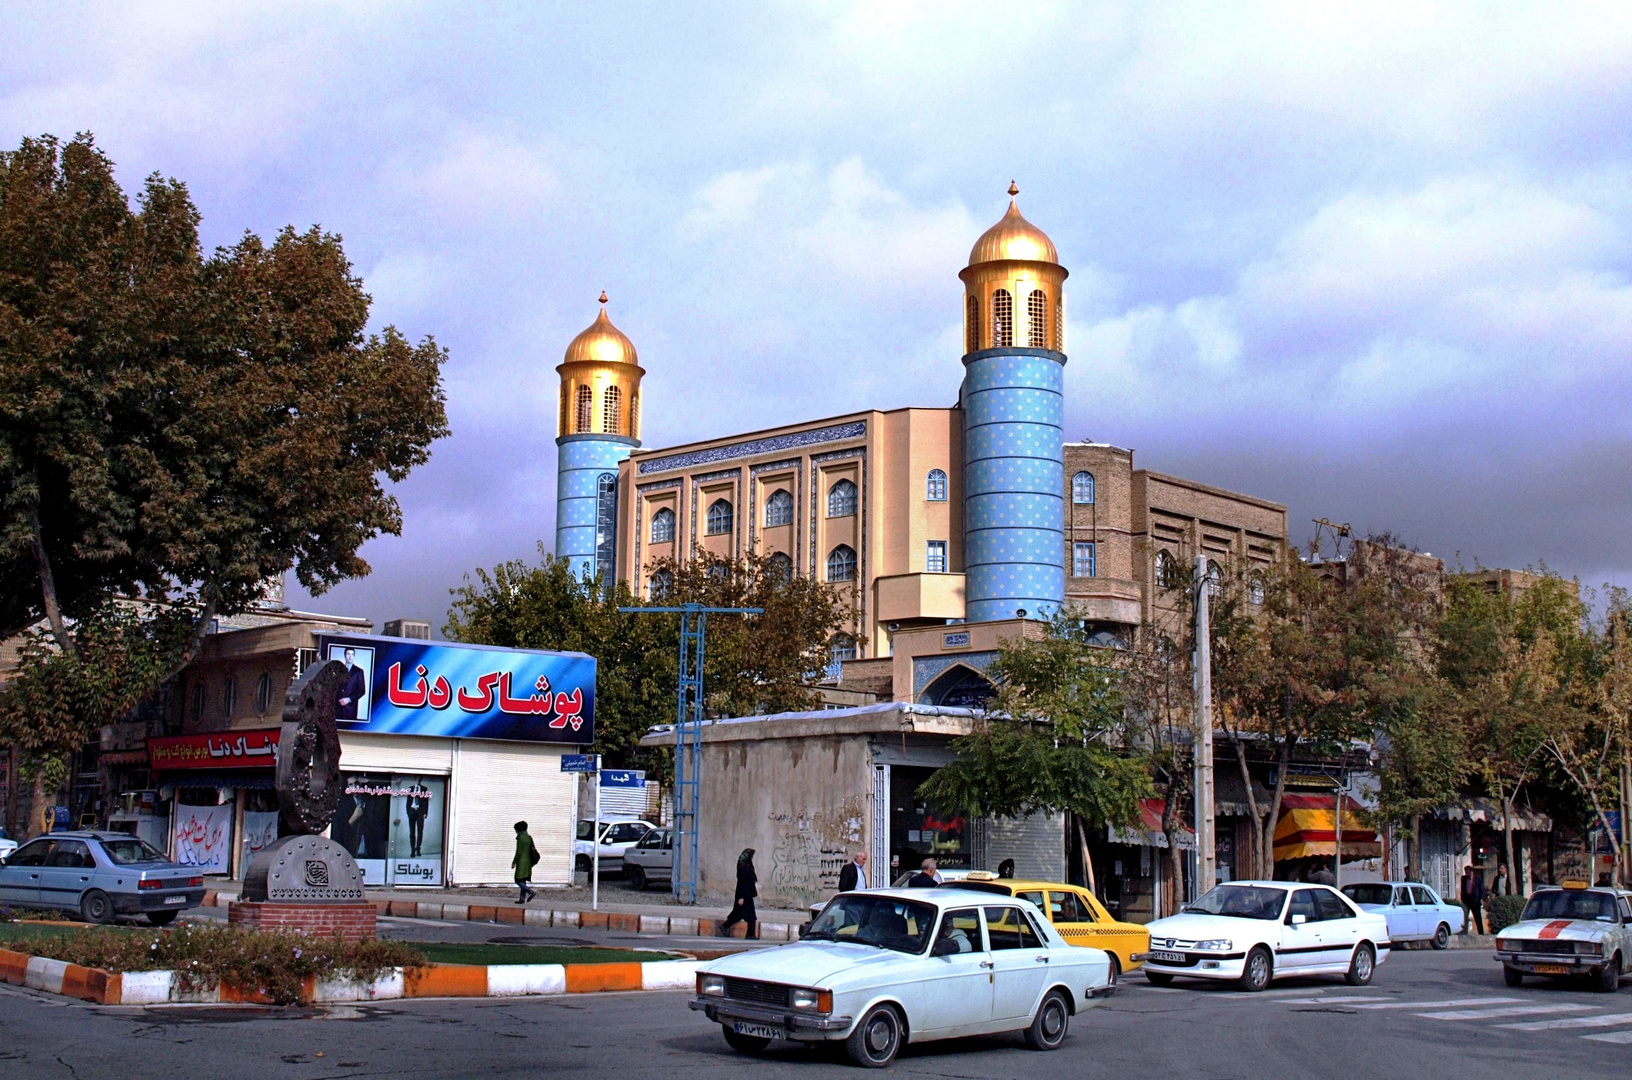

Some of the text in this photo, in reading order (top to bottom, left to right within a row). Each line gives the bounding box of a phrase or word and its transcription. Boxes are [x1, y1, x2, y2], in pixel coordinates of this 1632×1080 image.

[388, 661, 584, 731] پوشاک دنا
[208, 736, 280, 760] وشاک دنا
[394, 863, 434, 880] پوشاک
